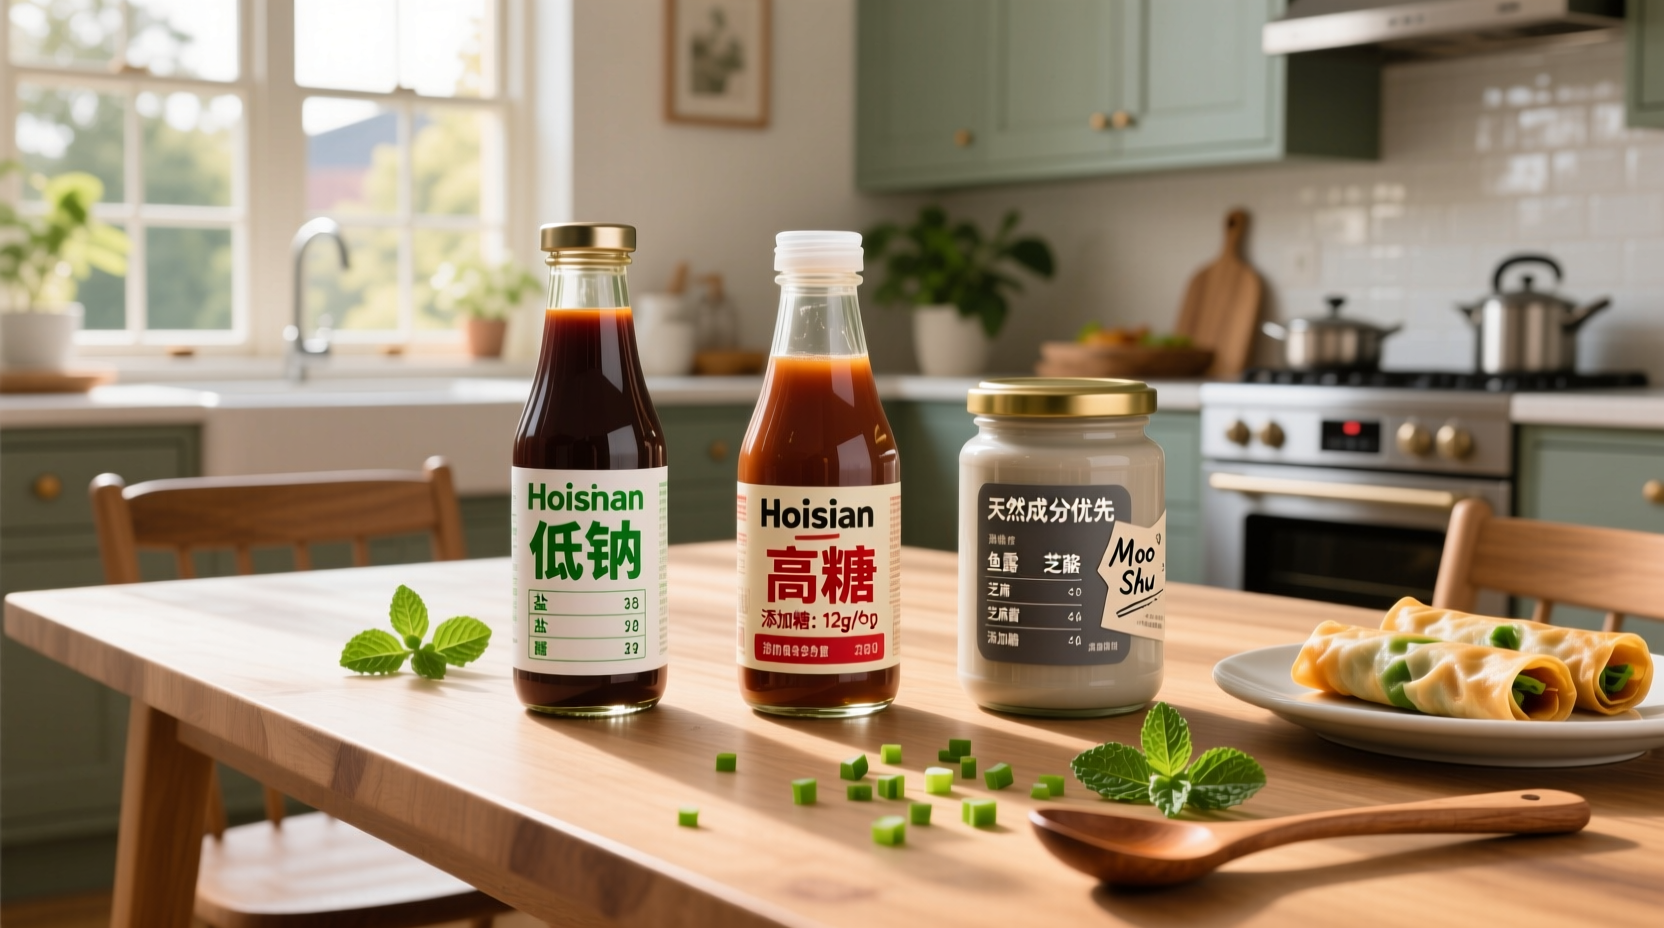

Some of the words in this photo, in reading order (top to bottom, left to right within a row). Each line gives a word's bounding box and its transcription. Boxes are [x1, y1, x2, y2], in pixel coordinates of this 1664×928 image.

[761, 498, 874, 529] Hoisian
[987, 496, 1115, 523] 天然成分优先
[529, 520, 641, 580] 低钠
[1108, 536, 1155, 568] Moo
[767, 545, 877, 604] 高糖
[1119, 567, 1156, 595] Shu
